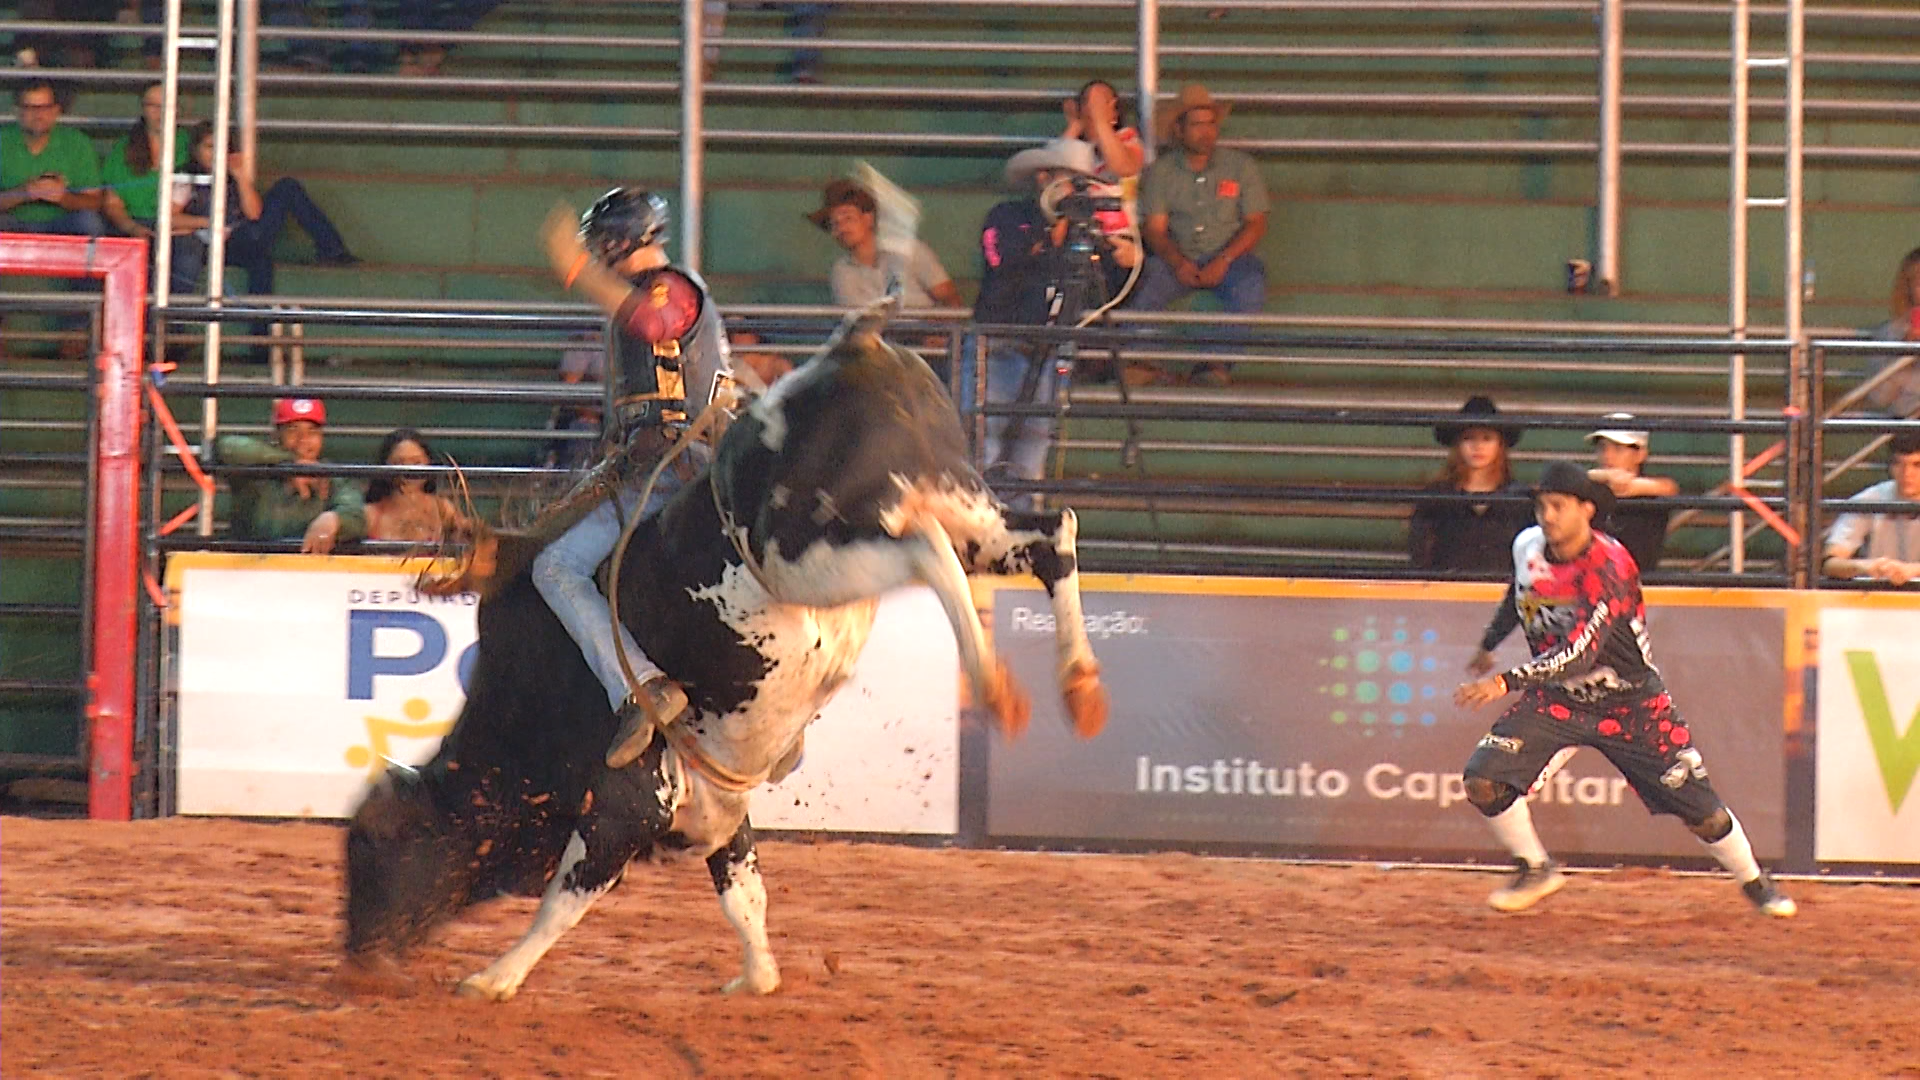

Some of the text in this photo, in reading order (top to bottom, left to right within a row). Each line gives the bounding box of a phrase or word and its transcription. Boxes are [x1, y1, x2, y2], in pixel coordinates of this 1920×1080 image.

[349, 609, 480, 700] P
[1136, 756, 1350, 798] Instituto
[1364, 763, 1629, 807] Capitar
